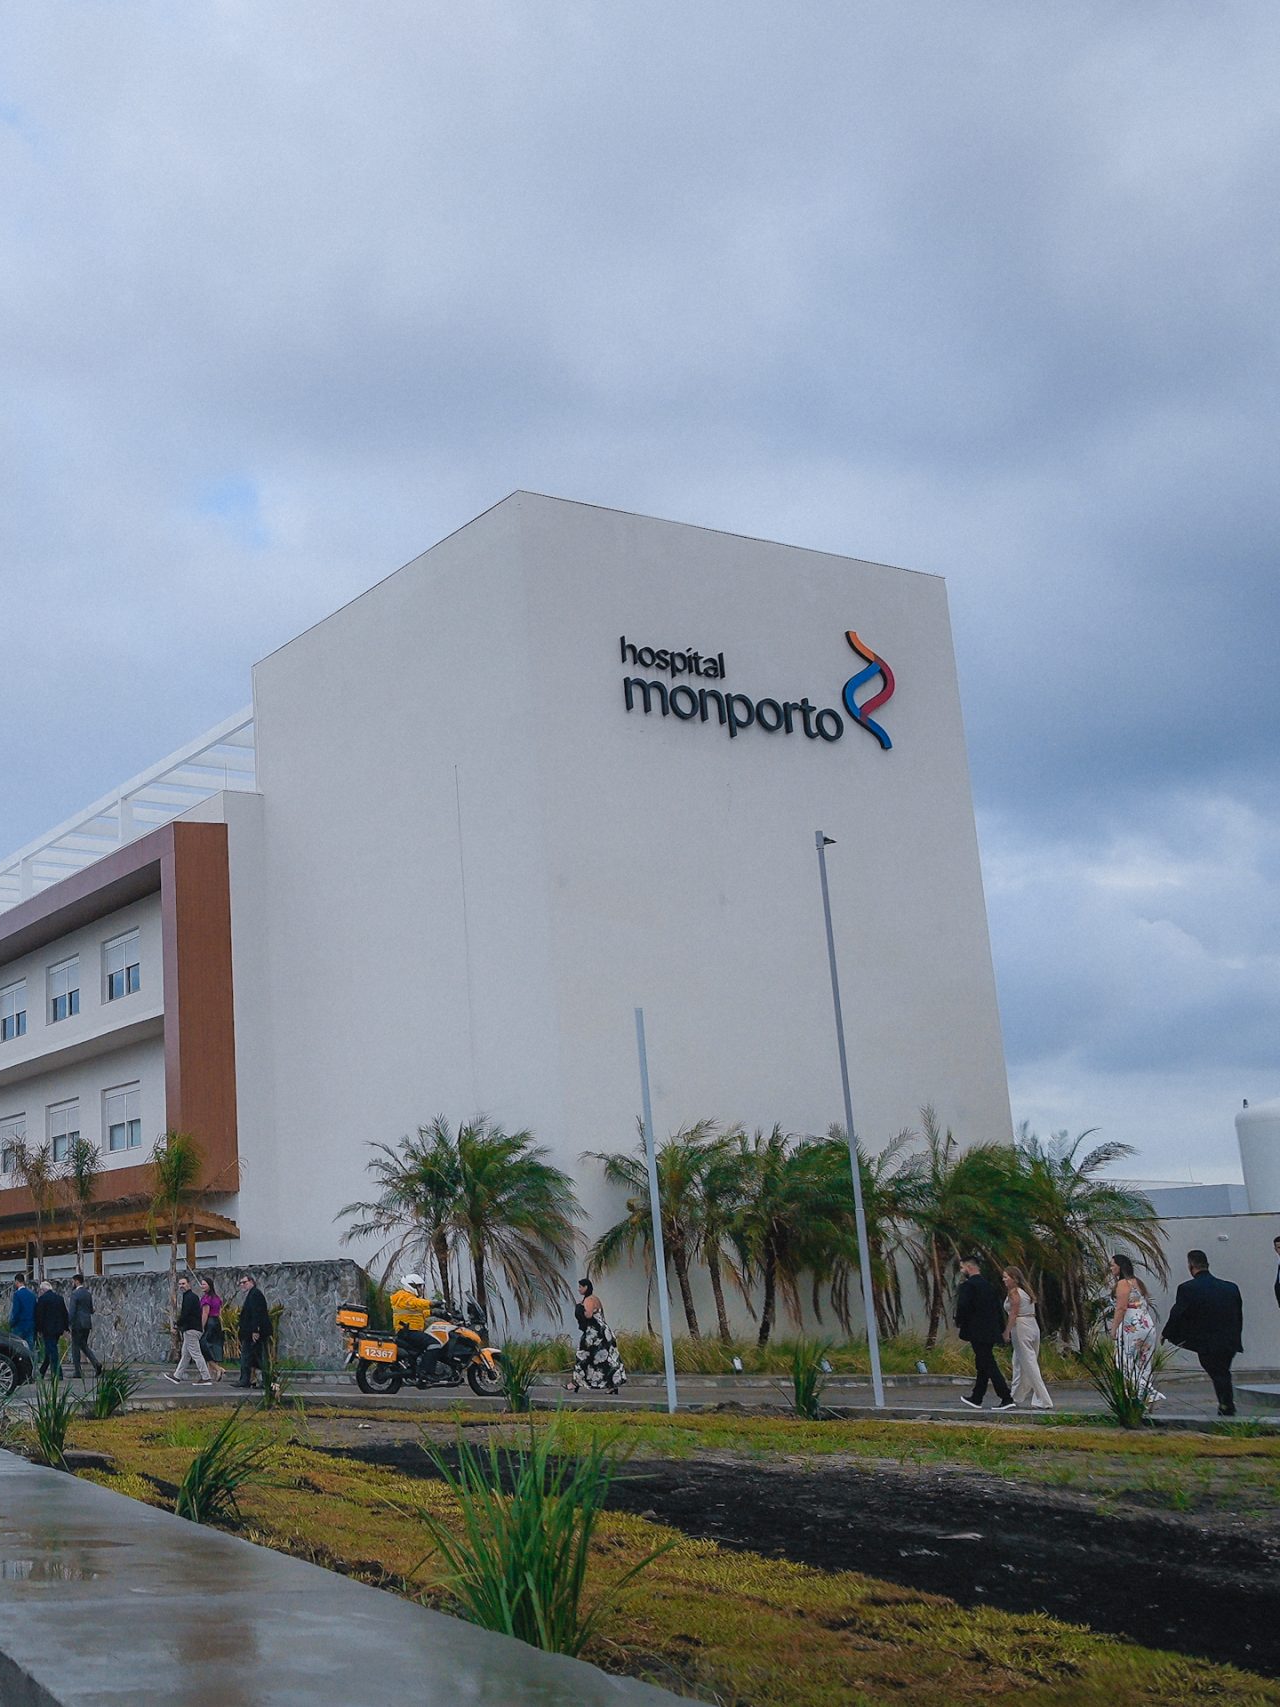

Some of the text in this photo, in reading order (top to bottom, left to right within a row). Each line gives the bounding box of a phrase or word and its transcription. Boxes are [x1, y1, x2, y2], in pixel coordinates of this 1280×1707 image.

[620, 635, 726, 680] hospital
[623, 675, 845, 742] monporto
[364, 1348, 394, 1359] 12367
